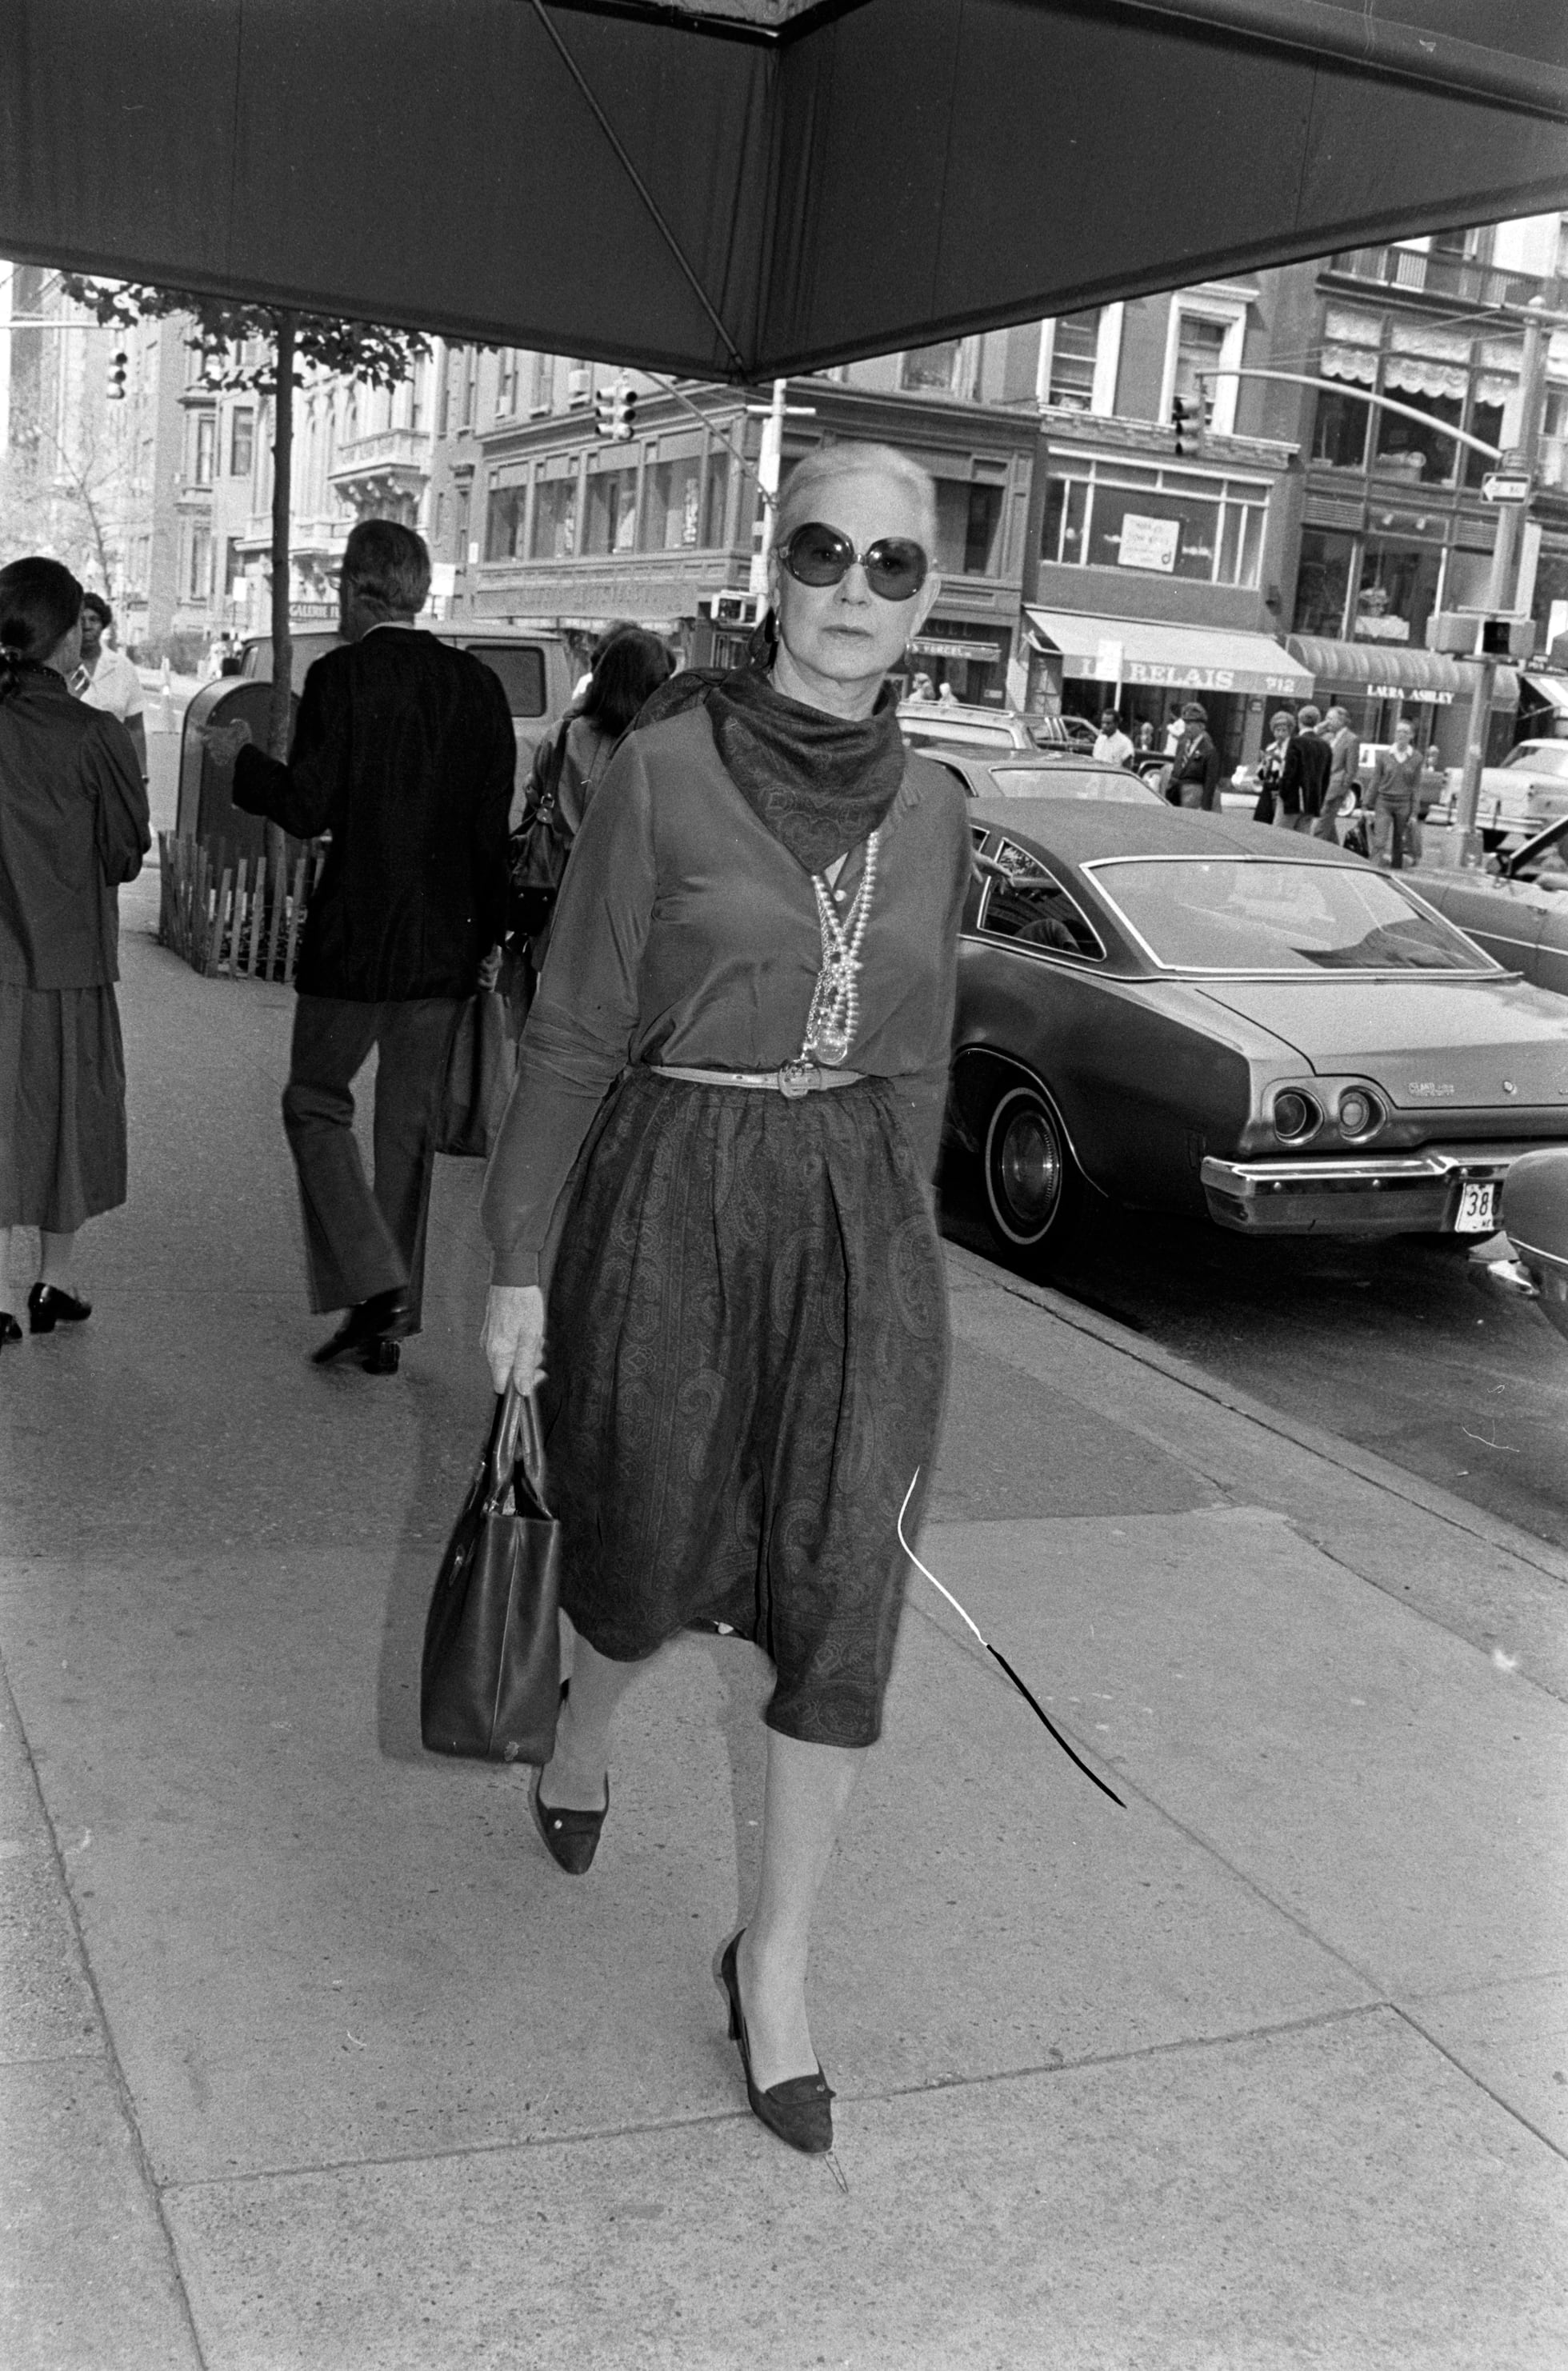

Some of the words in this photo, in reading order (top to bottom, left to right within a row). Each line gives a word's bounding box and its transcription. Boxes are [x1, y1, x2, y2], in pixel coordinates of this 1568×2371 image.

[1129, 662, 1235, 689] RELAIS
[1366, 684, 1404, 699] LAURA
[1409, 689, 1455, 705] ASHLEY
